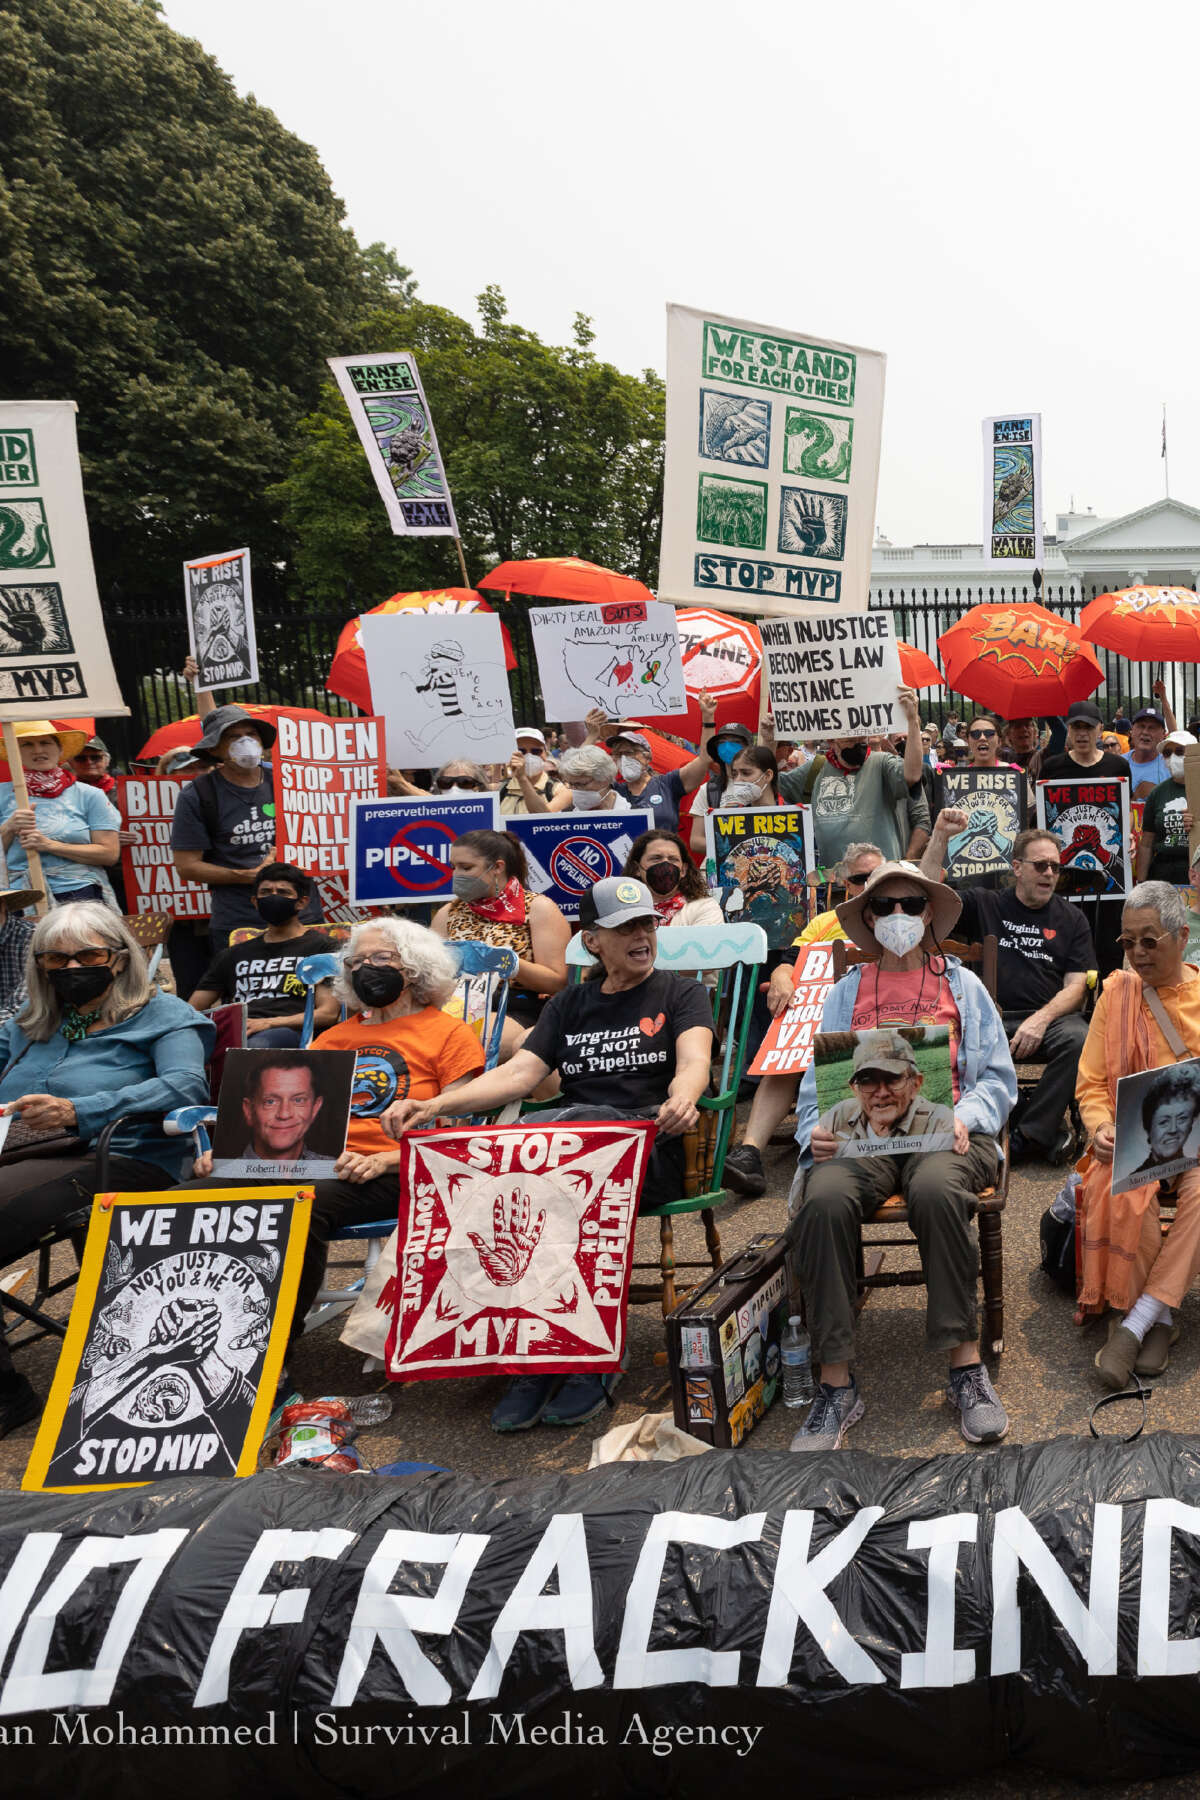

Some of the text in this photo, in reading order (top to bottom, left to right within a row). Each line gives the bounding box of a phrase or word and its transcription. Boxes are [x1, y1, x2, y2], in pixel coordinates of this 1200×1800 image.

[710, 328, 850, 381] WE STAND
[708, 356, 849, 401] FOR EACH OTHER
[191, 560, 240, 586] WE RISE
[700, 558, 835, 596] STOP MVP
[532, 605, 644, 626] DIRTY DEAL GUTS
[574, 622, 643, 638] AMAZON OF
[759, 616, 888, 646] WHEN INJUSTICE
[204, 664, 225, 682] STOP
[769, 650, 834, 675] BECOMES
[840, 646, 884, 670] LAW
[12, 667, 75, 696] MVP
[769, 677, 855, 703] RESISTANCE
[775, 703, 895, 732] BECOMES DUTY
[277, 716, 378, 761] BIDEN
[280, 763, 379, 791] STOP THE
[946, 774, 1016, 790] WE RISE
[126, 781, 191, 817] BID
[1047, 785, 1117, 803] WE RISE
[365, 804, 485, 822] preservethenrv.com
[717, 813, 799, 835] WE RISE
[1058, 810, 1071, 823] NOT
[128, 822, 173, 844] STO
[233, 819, 276, 835] clea
[284, 813, 349, 845] VALL
[533, 824, 570, 835] protect
[593, 821, 623, 830] water
[366, 844, 452, 868] PIPELI
[578, 845, 600, 866] NO
[557, 858, 591, 888] PIPELINE
[1002, 920, 1040, 934] Virginia
[1020, 937, 1044, 947] NOT
[235, 956, 303, 977] GREE
[235, 974, 287, 993] NEW
[565, 1025, 640, 1048] Virginia
[580, 1037, 641, 1058] is NOT
[562, 1049, 667, 1076] for Pipelines
[467, 1132, 584, 1173] STOP
[120, 1204, 284, 1247] WE RISE
[580, 1220, 600, 1254] NO
[403, 1183, 438, 1314] SOUTHGATE
[427, 1227, 449, 1260] NO
[593, 1178, 633, 1307] PIPELINE
[129, 1252, 256, 1297] NOT JUST FOR
[154, 1271, 230, 1297] YOU & ME
[454, 1316, 552, 1358] MVP
[73, 1433, 220, 1476] STOP MVP
